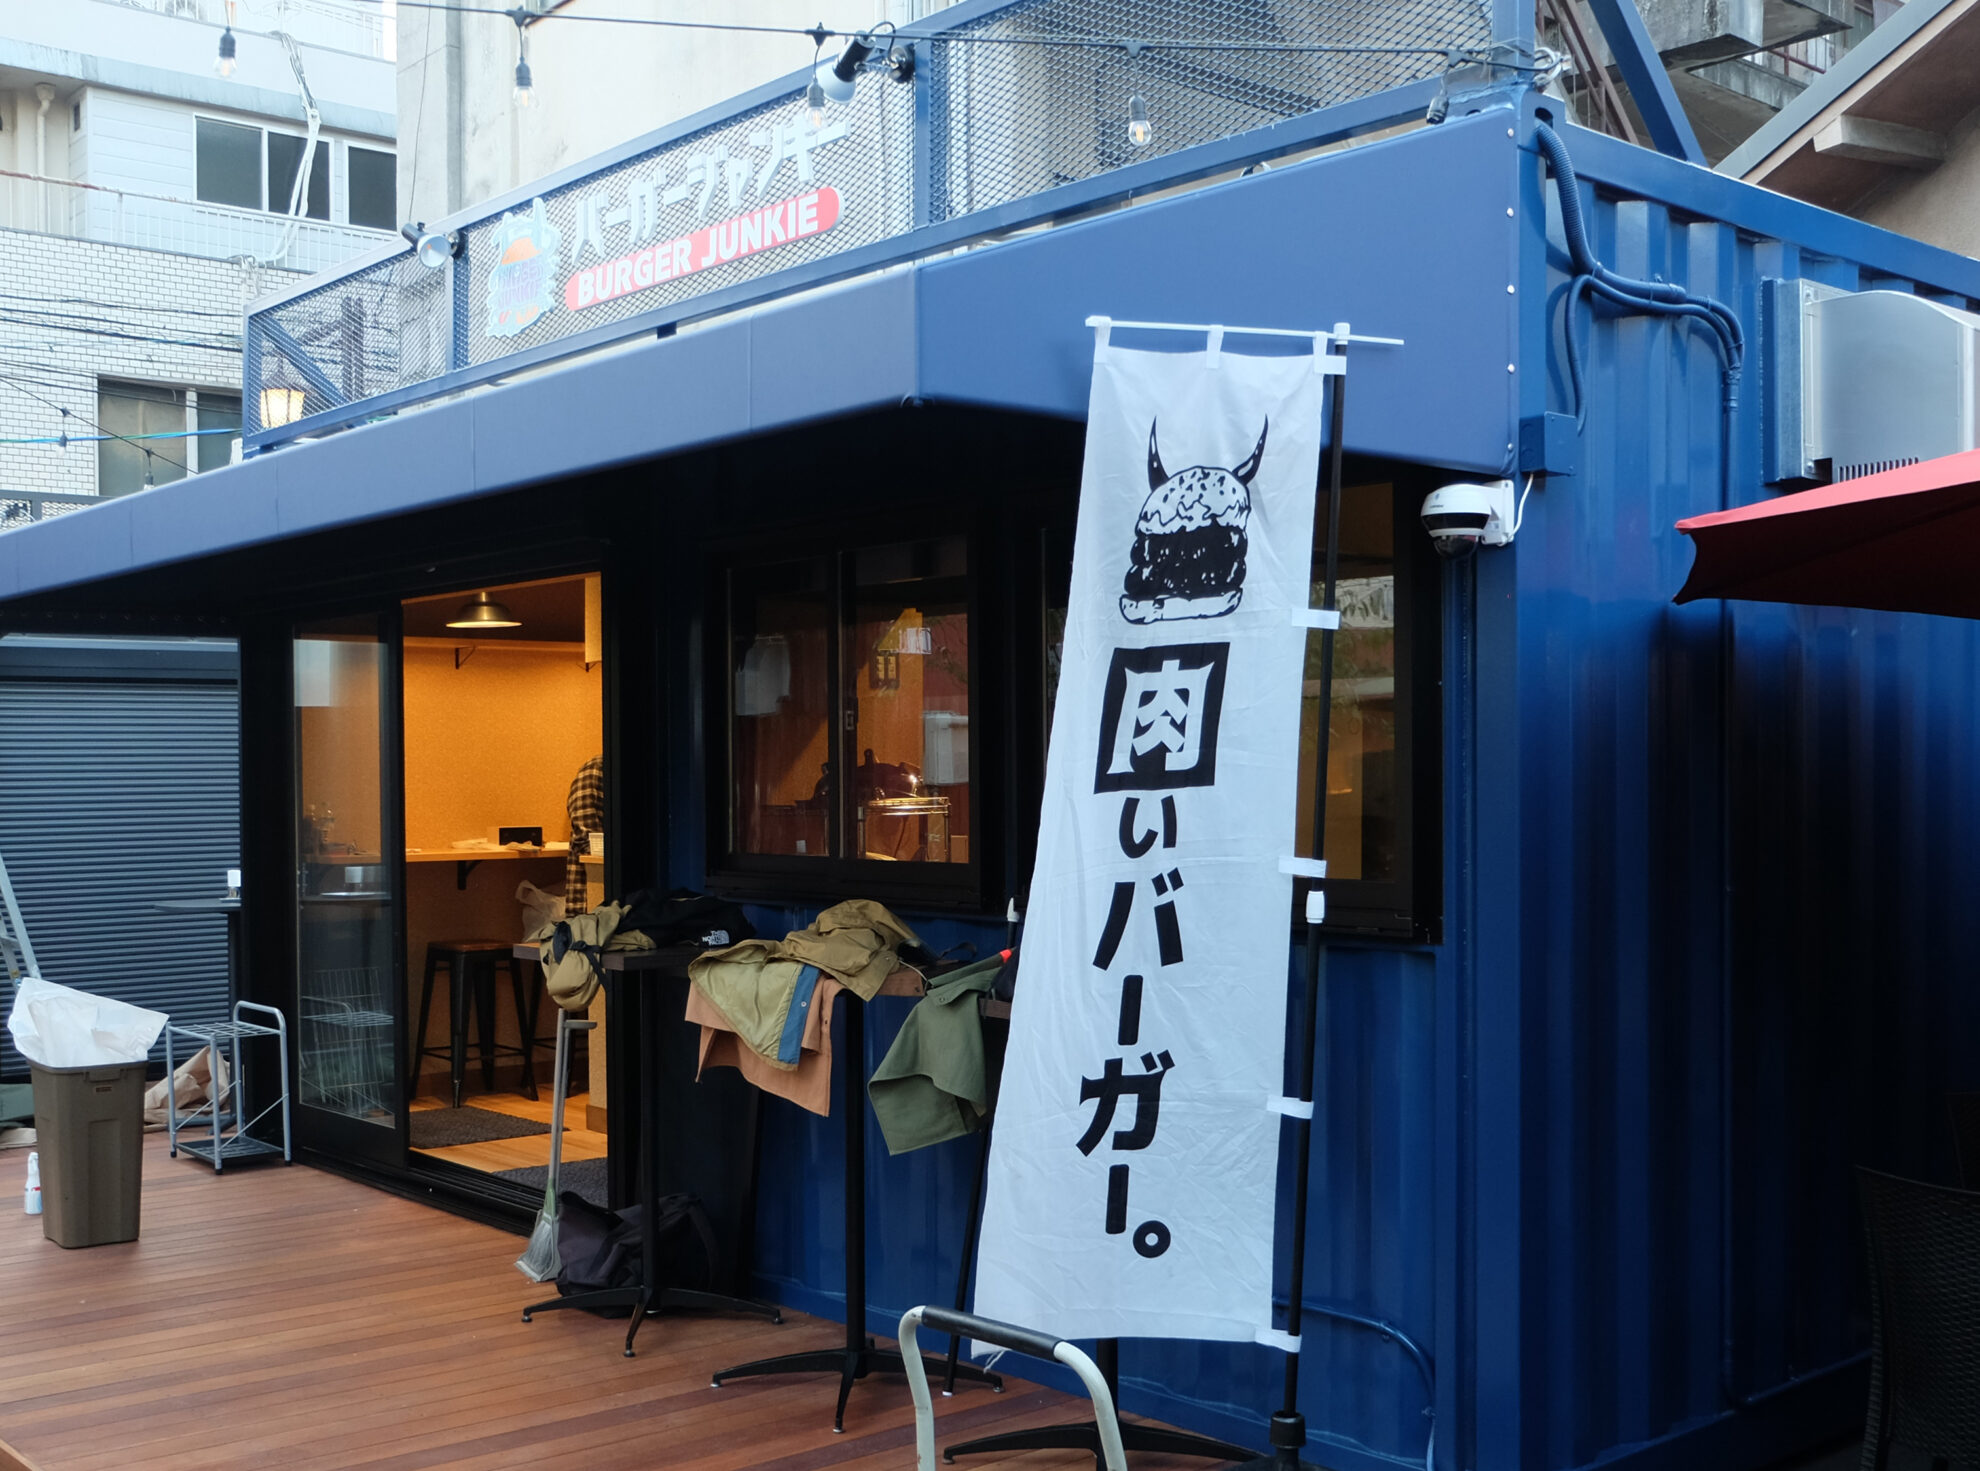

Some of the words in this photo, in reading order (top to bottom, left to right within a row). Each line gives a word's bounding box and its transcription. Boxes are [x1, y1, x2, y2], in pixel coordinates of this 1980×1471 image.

[578, 239, 693, 307] BURGER
[702, 192, 819, 267] JUNKIE
[1076, 655, 1220, 1258] 肉いバーガー。
